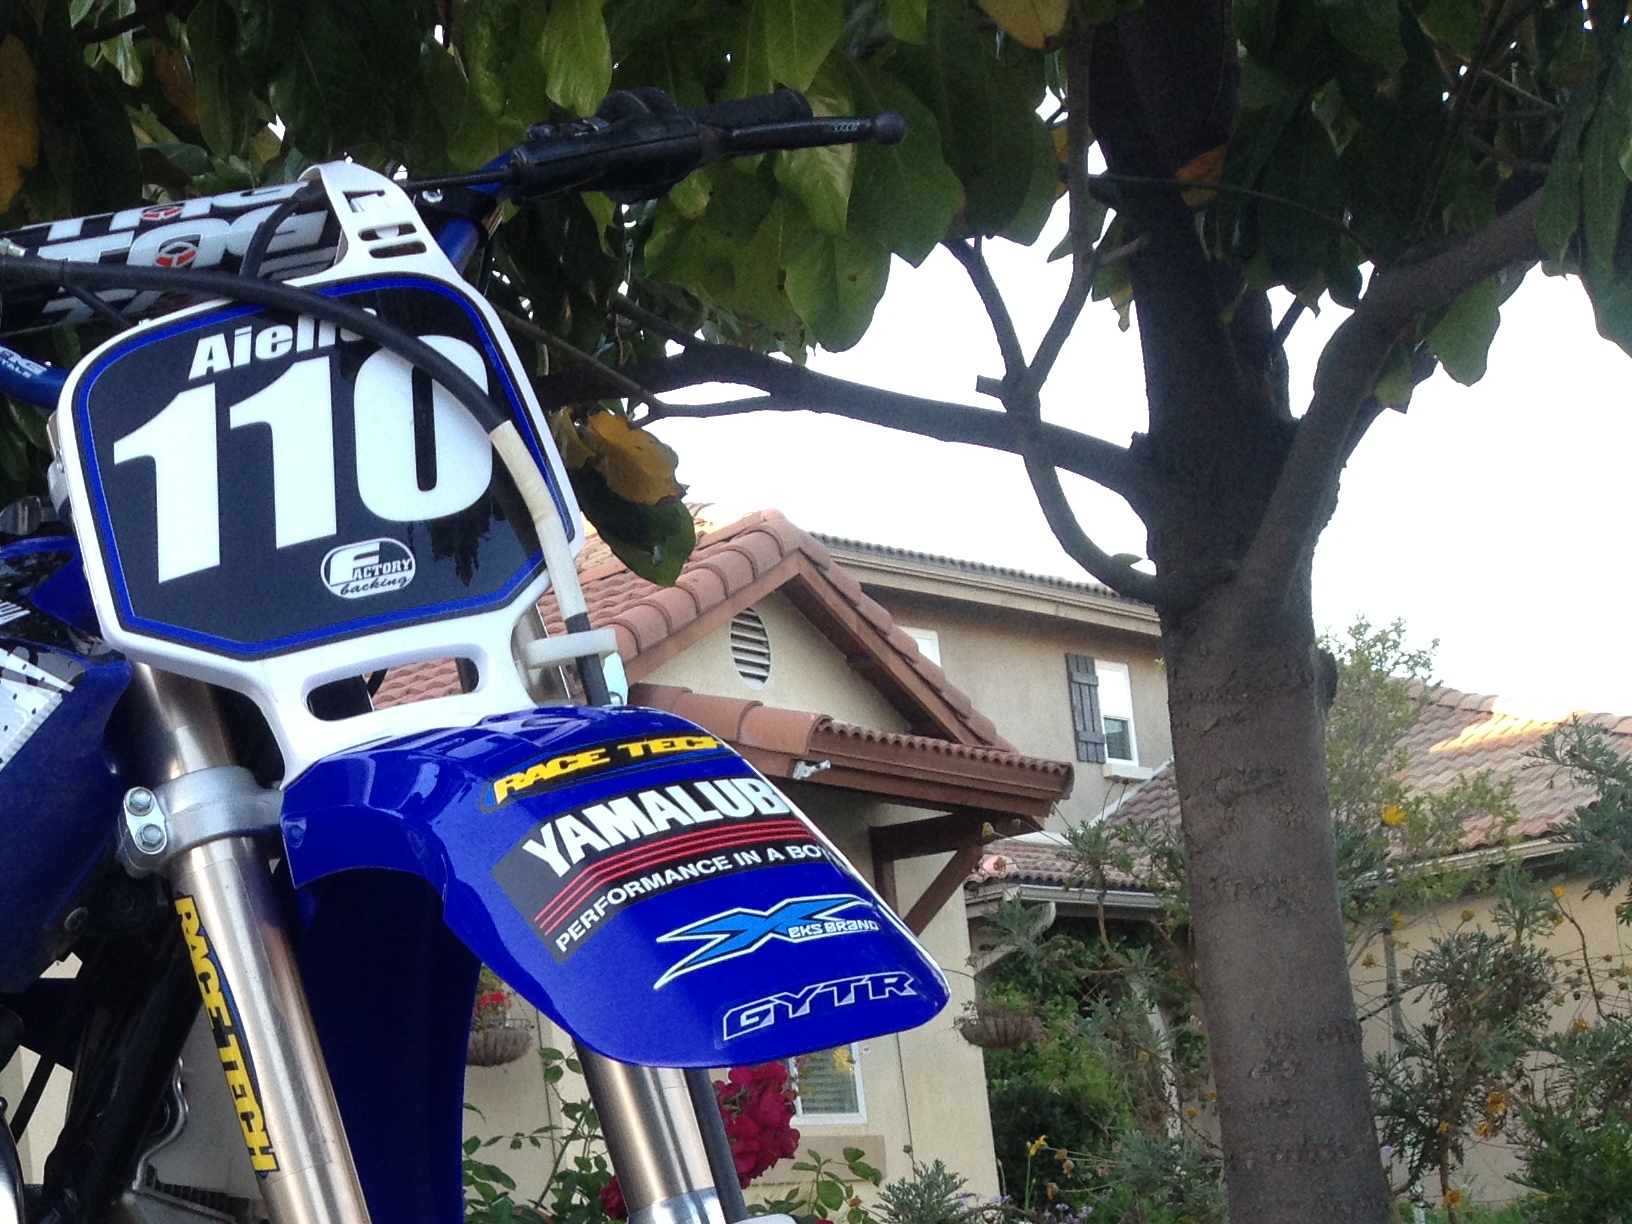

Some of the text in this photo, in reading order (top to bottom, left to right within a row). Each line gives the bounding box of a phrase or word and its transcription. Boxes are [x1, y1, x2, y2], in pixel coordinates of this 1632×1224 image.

[113, 334, 493, 584] 110
[493, 747, 611, 805] RACE
[522, 776, 792, 877] YAMALUB
[555, 855, 733, 953] PERFORMANCE
[733, 850, 762, 867] IN
[767, 847, 786, 861] A
[174, 895, 280, 1172] RACE TECH
[722, 970, 918, 1041] GYTR
